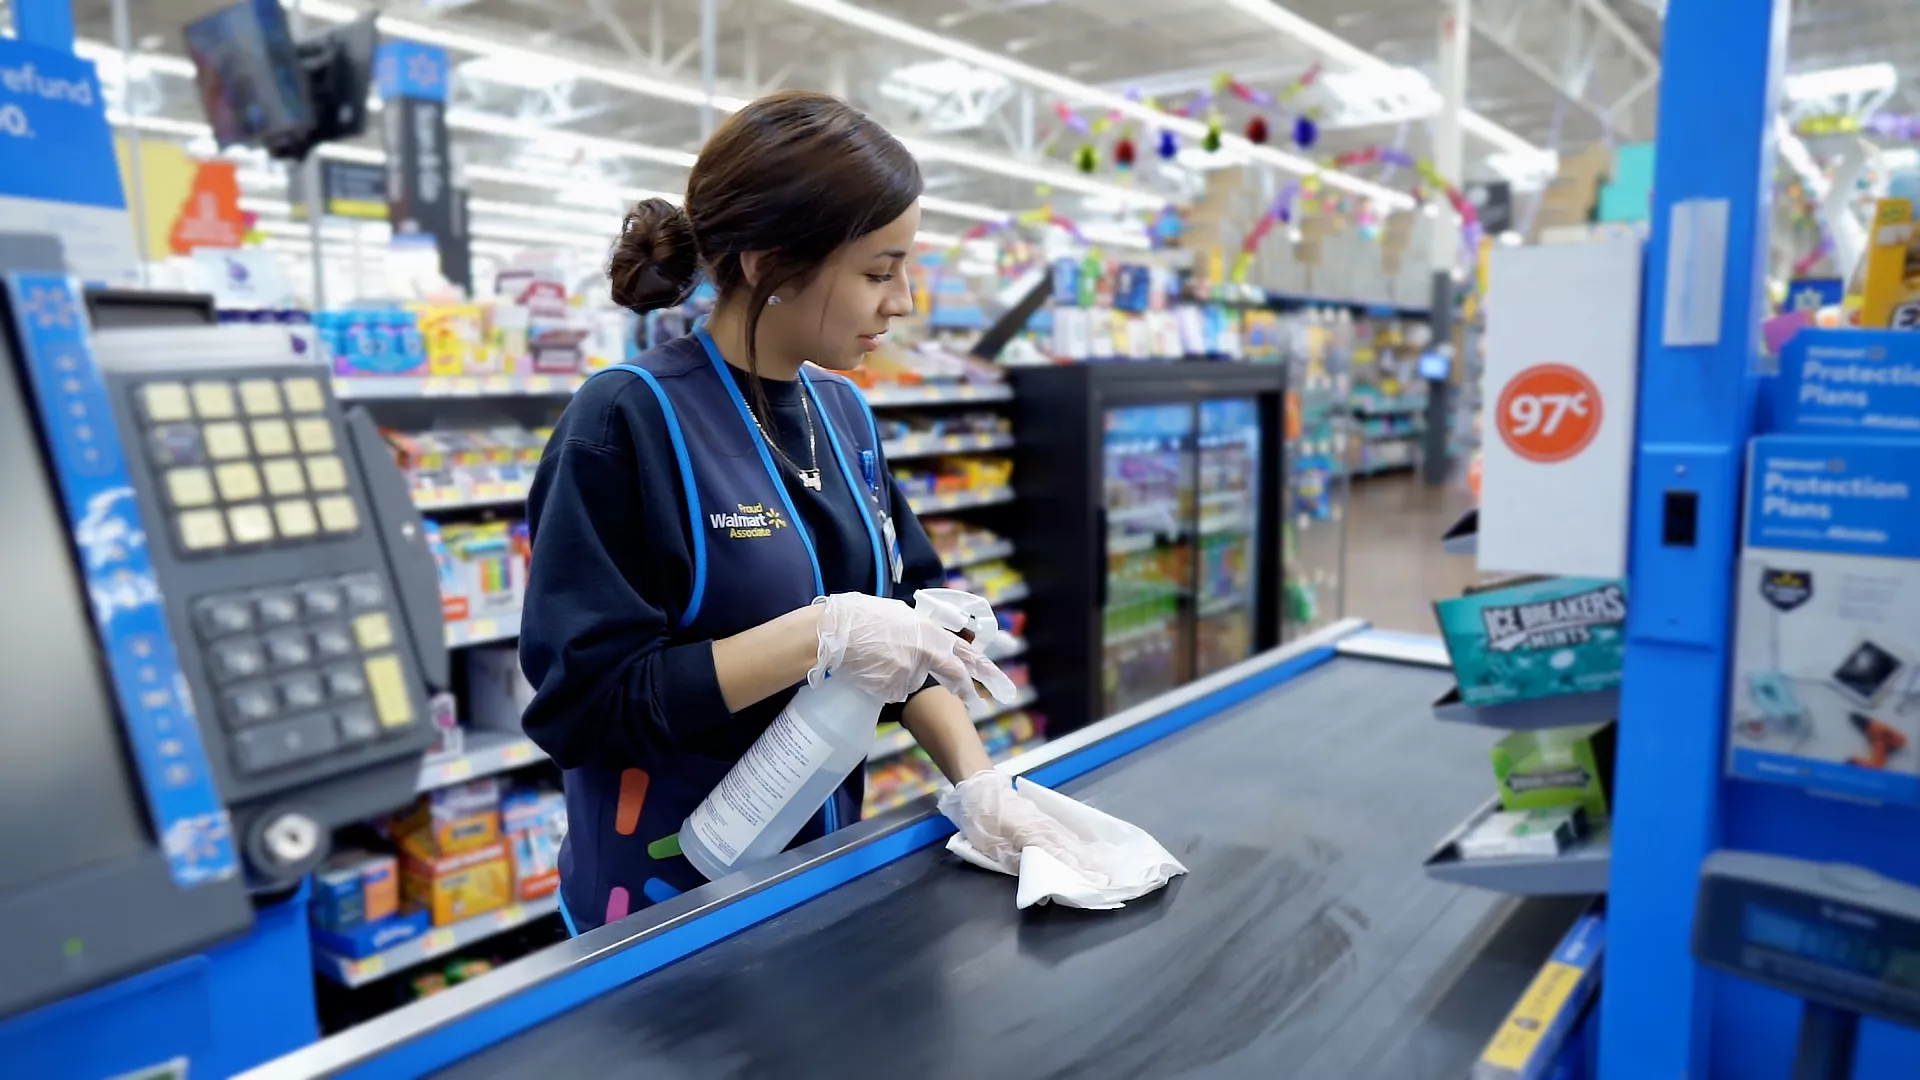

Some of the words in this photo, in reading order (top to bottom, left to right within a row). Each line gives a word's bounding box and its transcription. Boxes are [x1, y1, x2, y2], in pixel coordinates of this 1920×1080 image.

[0, 63, 92, 106] efund
[1799, 384, 1868, 408] Plans
[1509, 391, 1589, 437] 97¢
[1763, 472, 1909, 499] Protection
[737, 502, 763, 514] Proud
[1762, 496, 1832, 521] Plans
[710, 513, 768, 528] Walmart
[729, 528, 772, 538] Associate
[1484, 607, 1525, 641] ICE
[1519, 586, 1627, 630] BREAKERS
[1530, 626, 1593, 649] MINTS
